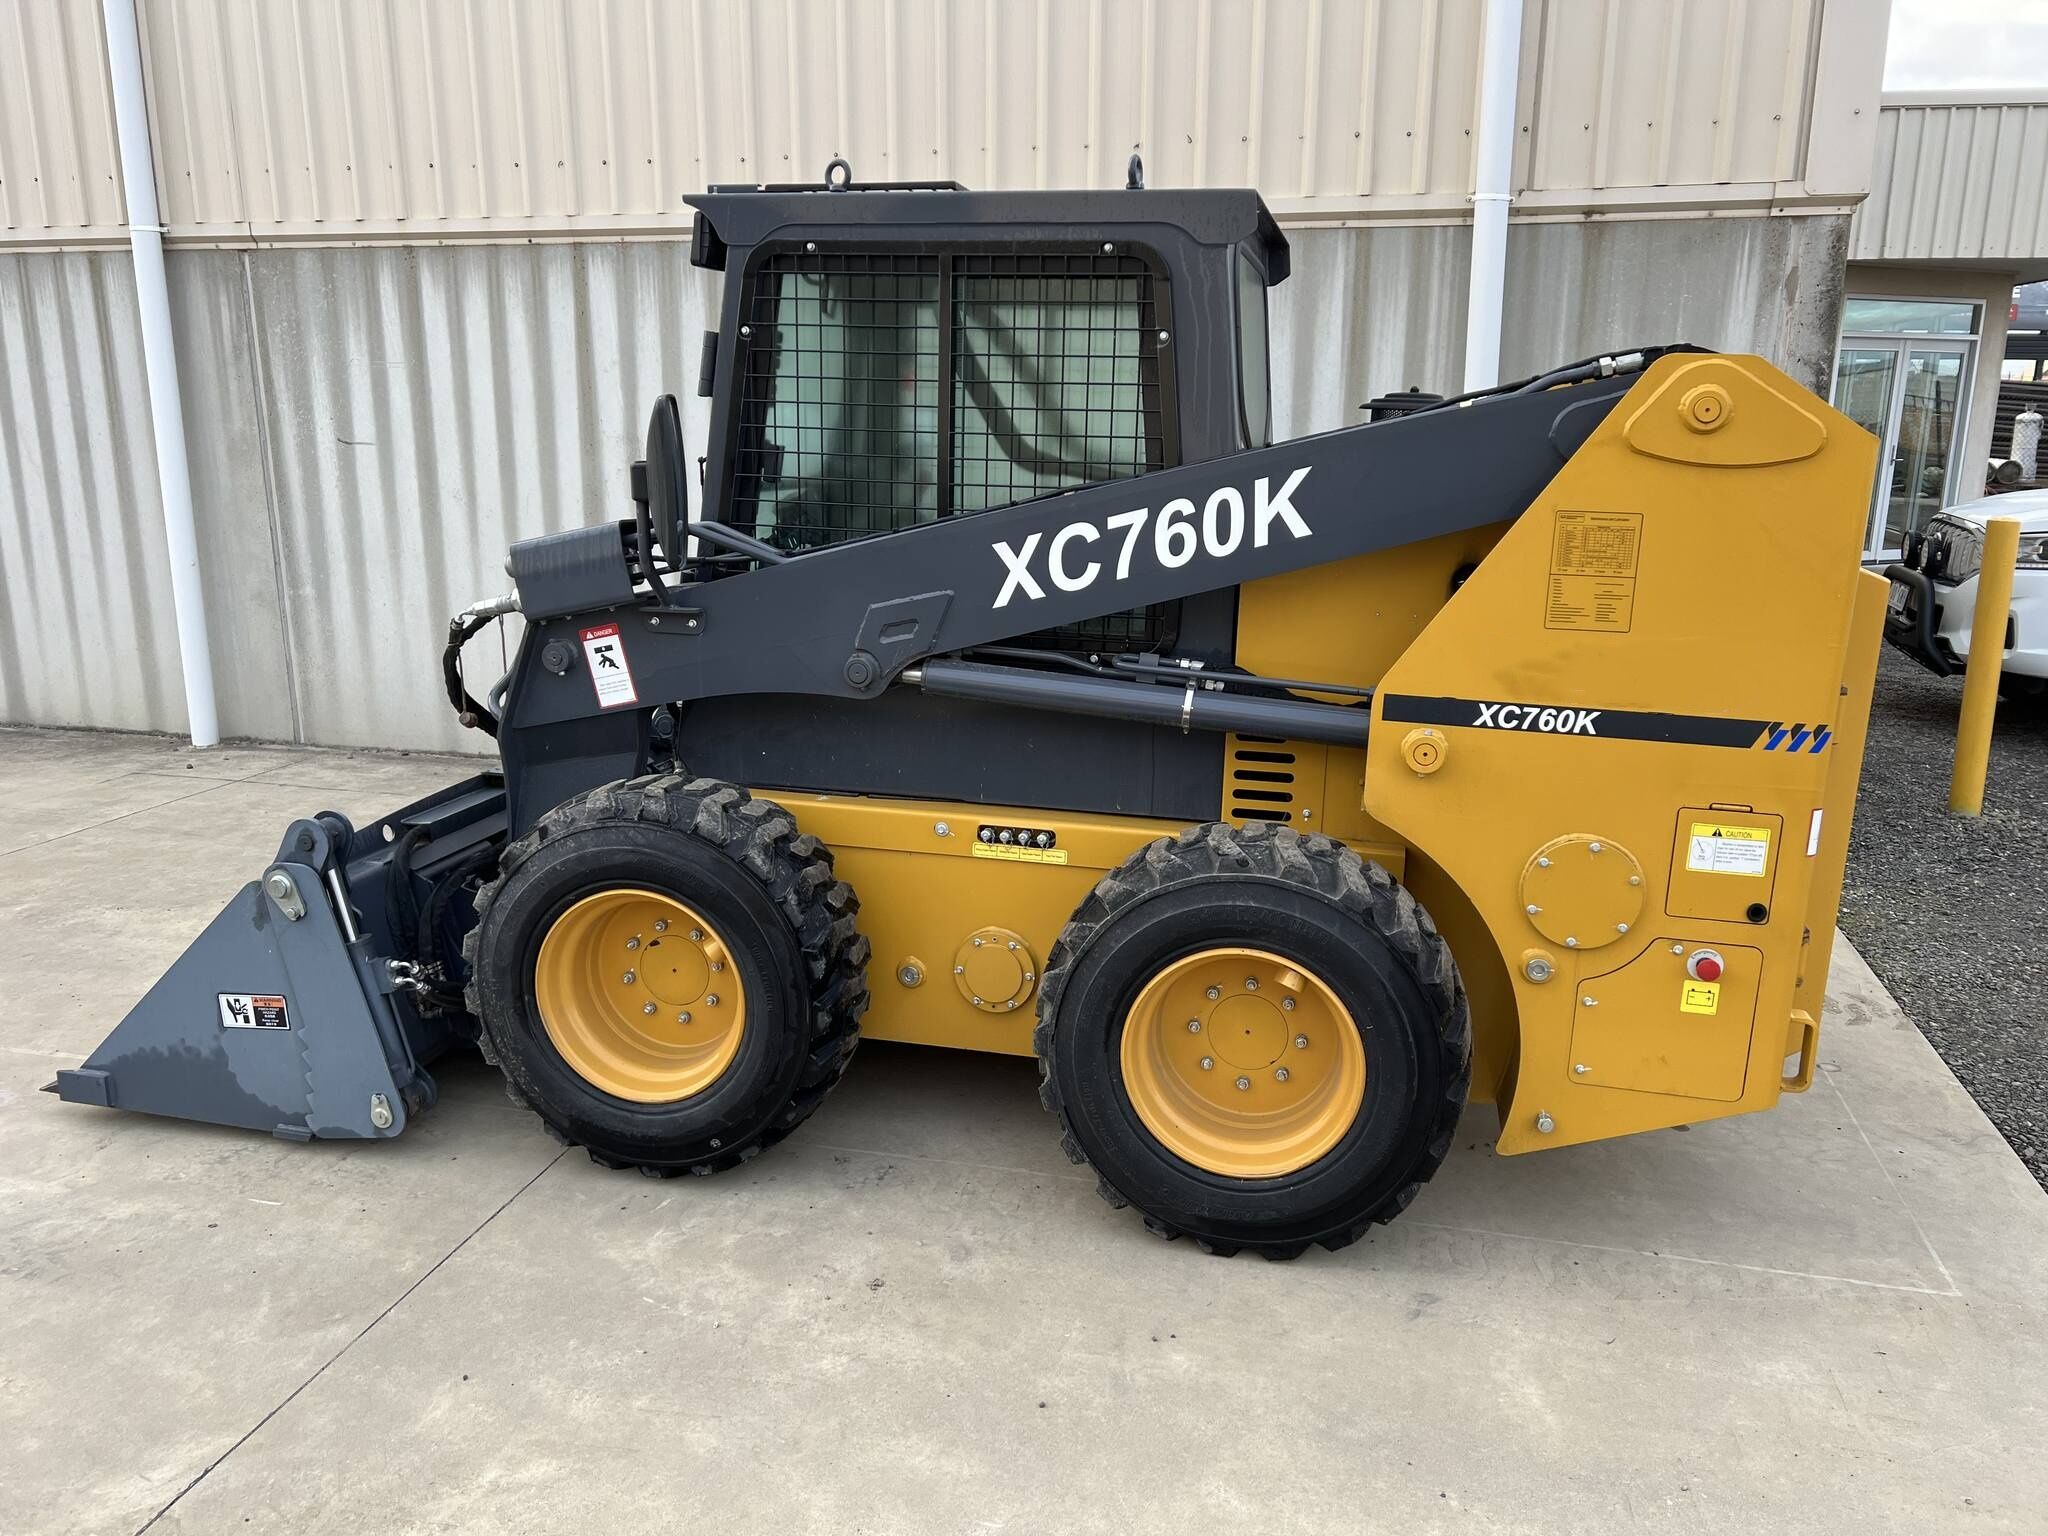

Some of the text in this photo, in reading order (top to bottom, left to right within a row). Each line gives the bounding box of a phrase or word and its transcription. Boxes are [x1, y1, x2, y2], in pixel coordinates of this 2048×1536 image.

[992, 466, 1313, 609] XC760K
[593, 628, 613, 637] DANGER
[1472, 703, 1602, 735] XC760K
[1725, 830, 1752, 839] CAUTION
